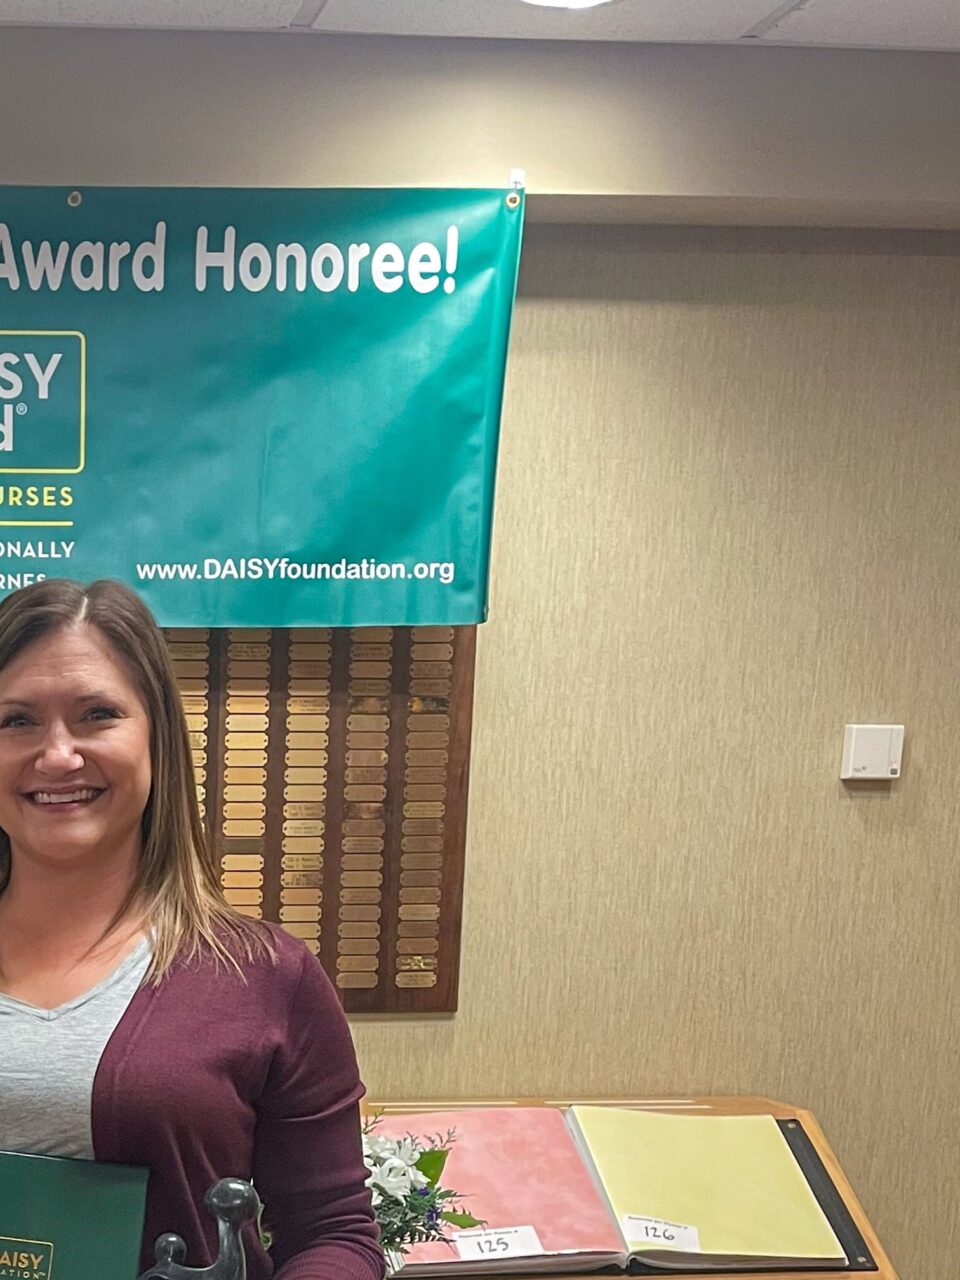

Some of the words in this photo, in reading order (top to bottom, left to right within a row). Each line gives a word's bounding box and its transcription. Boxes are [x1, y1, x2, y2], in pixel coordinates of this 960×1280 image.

[195, 224, 459, 294] Honoree!
[136, 558, 455, 584] www.DAISYfoundation.org
[644, 1226, 676, 1241] 126
[477, 1237, 509, 1253] 125
